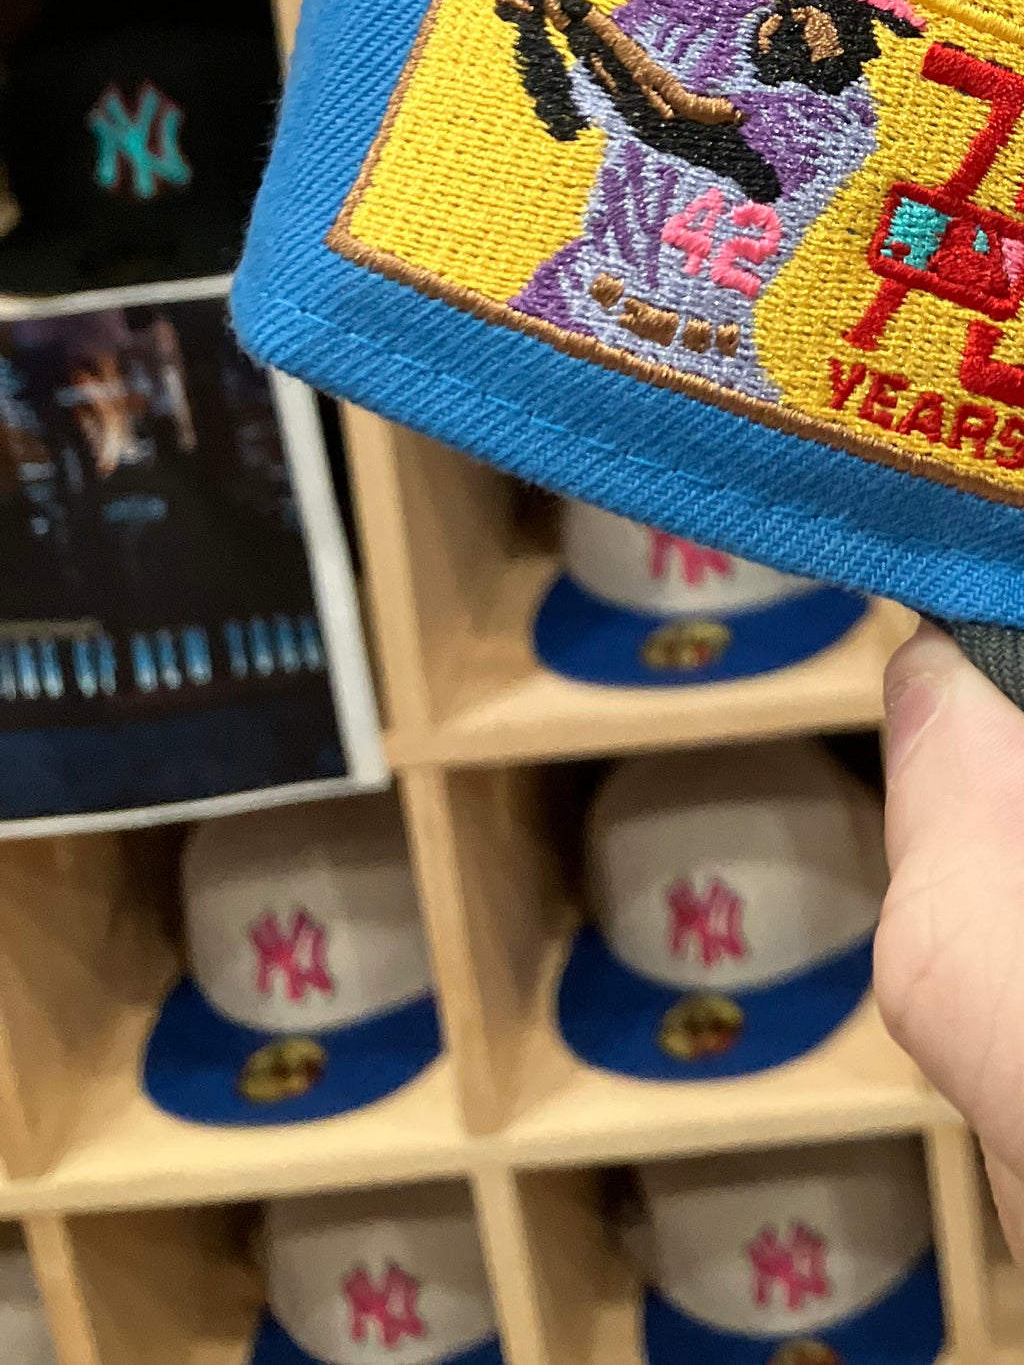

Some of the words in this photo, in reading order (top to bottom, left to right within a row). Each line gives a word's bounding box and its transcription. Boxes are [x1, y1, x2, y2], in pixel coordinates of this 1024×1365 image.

[87, 83, 192, 201] NY
[660, 187, 783, 302] 42
[246, 905, 336, 1003] NY
[663, 873, 750, 968] NY
